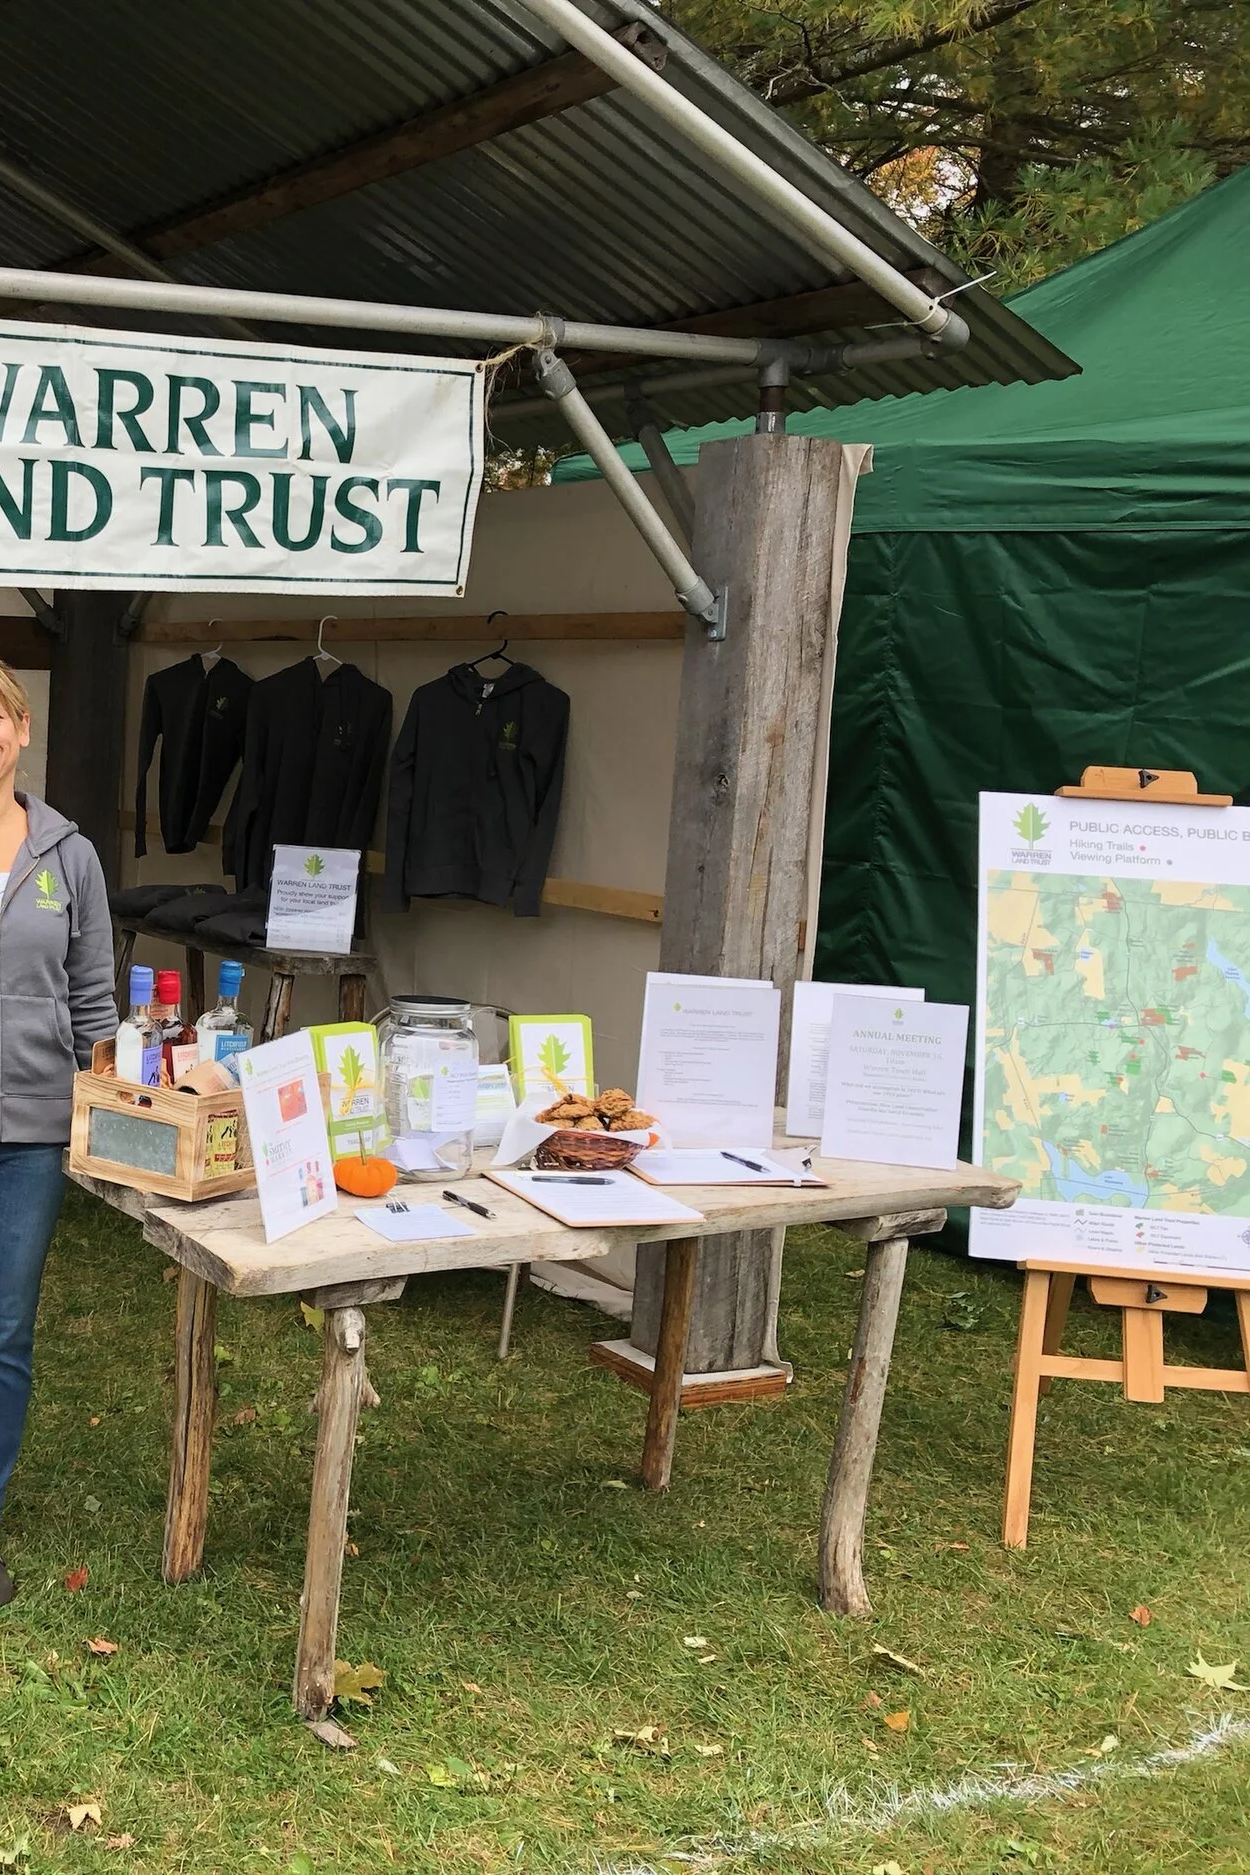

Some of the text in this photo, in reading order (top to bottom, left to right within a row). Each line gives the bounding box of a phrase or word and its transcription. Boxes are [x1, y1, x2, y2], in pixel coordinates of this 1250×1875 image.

[140, 466, 441, 554] TRUST
[1070, 820, 1238, 842] PUBLIC ACCESS, PUBLIC
[1070, 838, 1134, 852] Hiking Trails
[1011, 850, 1052, 860] WARREN
[1070, 851, 1161, 865] Viewing Platform
[277, 880, 307, 888] WARREN
[853, 1029, 942, 1045] ANNUAL MEETING
